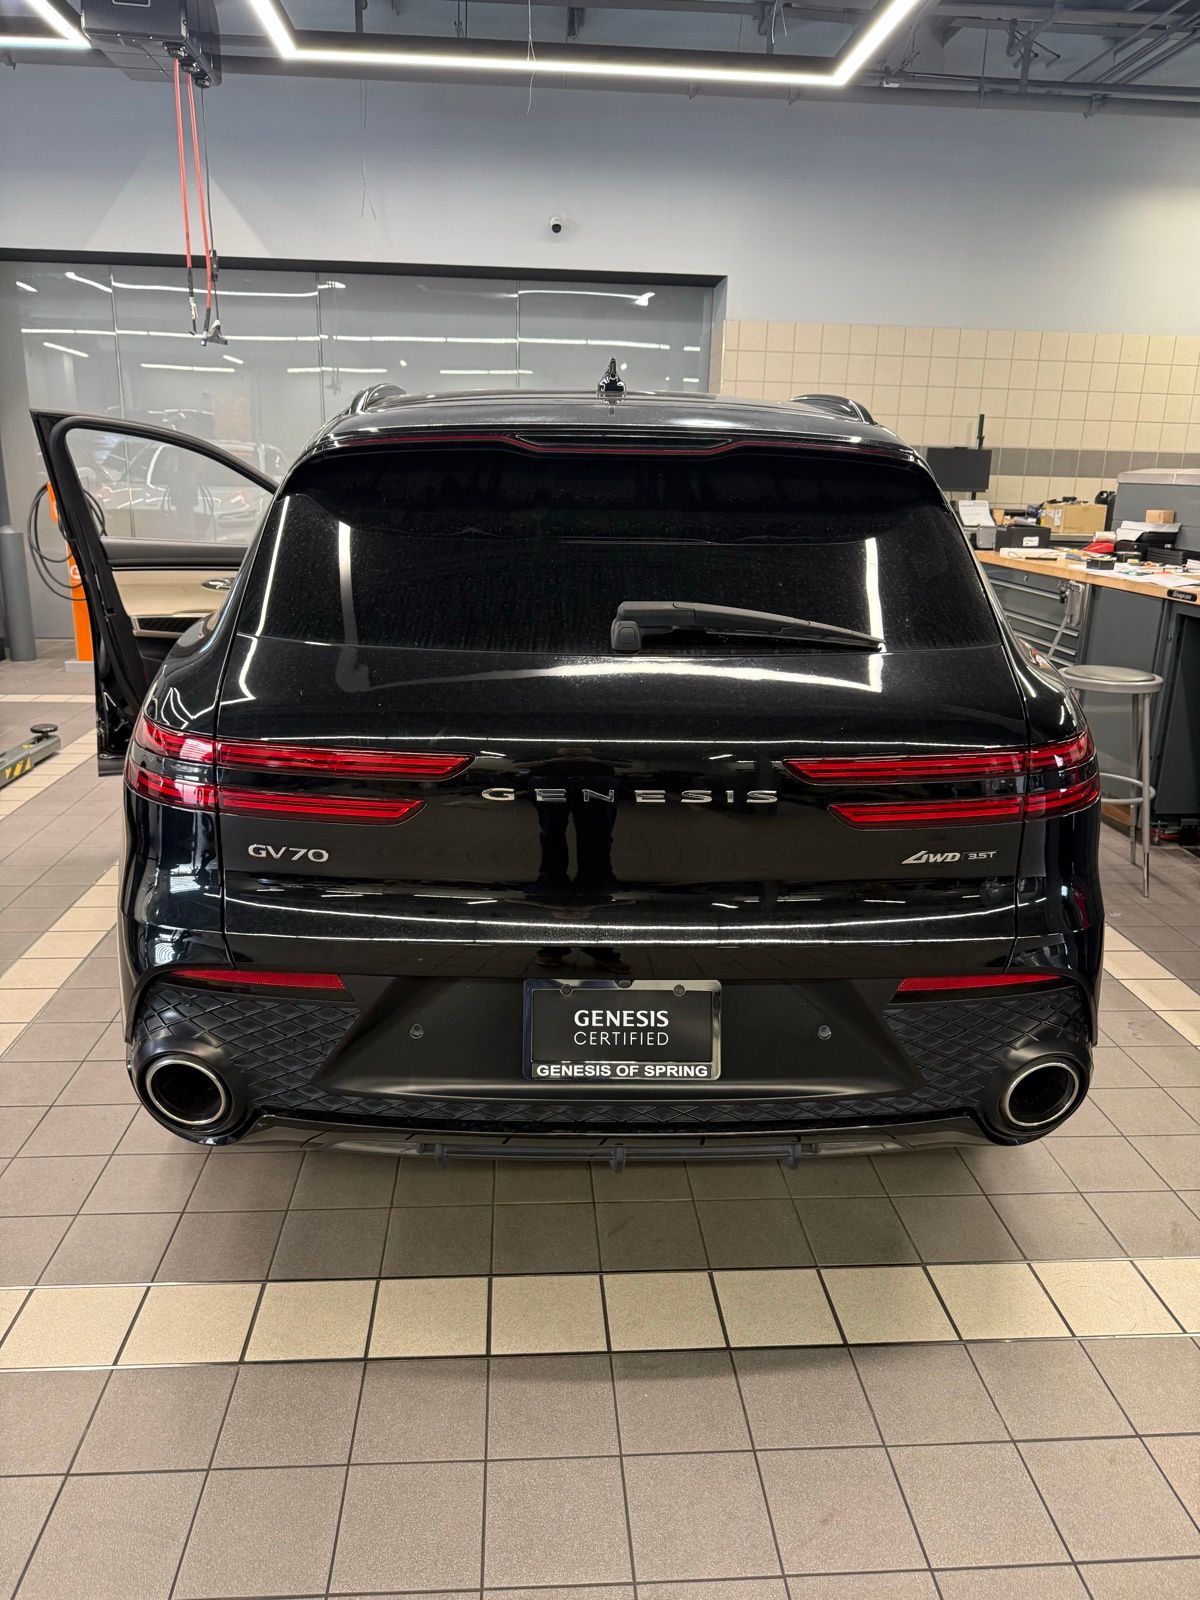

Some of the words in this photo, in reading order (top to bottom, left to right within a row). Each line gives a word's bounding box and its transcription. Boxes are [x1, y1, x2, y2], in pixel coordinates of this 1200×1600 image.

[481, 787, 778, 803] GENESIS
[247, 843, 329, 862] GV70
[573, 1009, 669, 1027] GENESIS
[573, 1031, 669, 1046] CERTIFIED
[536, 1065, 611, 1077] GENESIS
[616, 1065, 640, 1077] OF
[644, 1065, 708, 1077] SPRING
